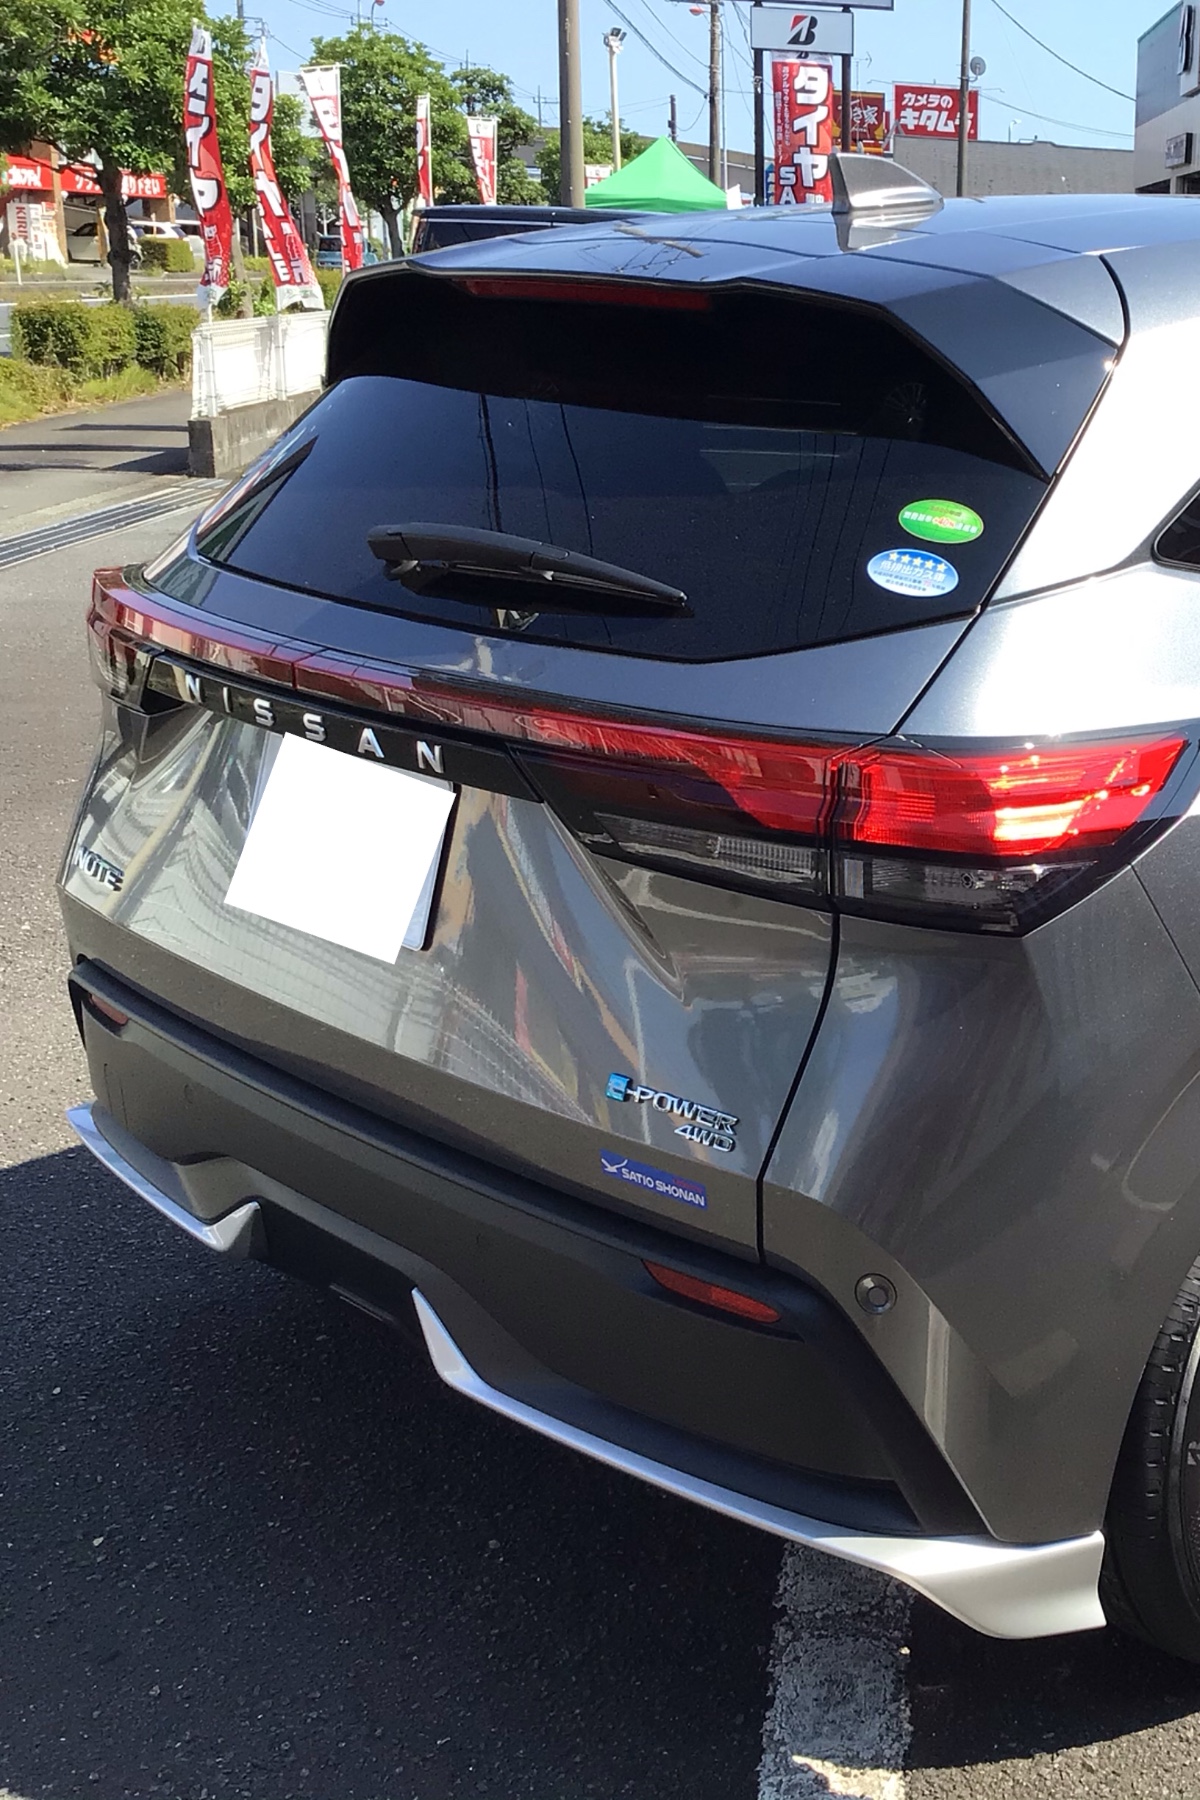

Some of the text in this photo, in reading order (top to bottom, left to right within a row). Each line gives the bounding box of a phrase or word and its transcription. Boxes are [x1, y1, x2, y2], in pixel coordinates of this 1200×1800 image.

[901, 92, 954, 109] カメラの
[793, 65, 829, 188] タイヤ
[184, 674, 445, 774] NISSAN
[74, 846, 124, 891] NOTE
[674, 1123, 735, 1153] 4WD
[621, 1167, 655, 1189] SATIO
[655, 1179, 706, 1207] SHONAN
